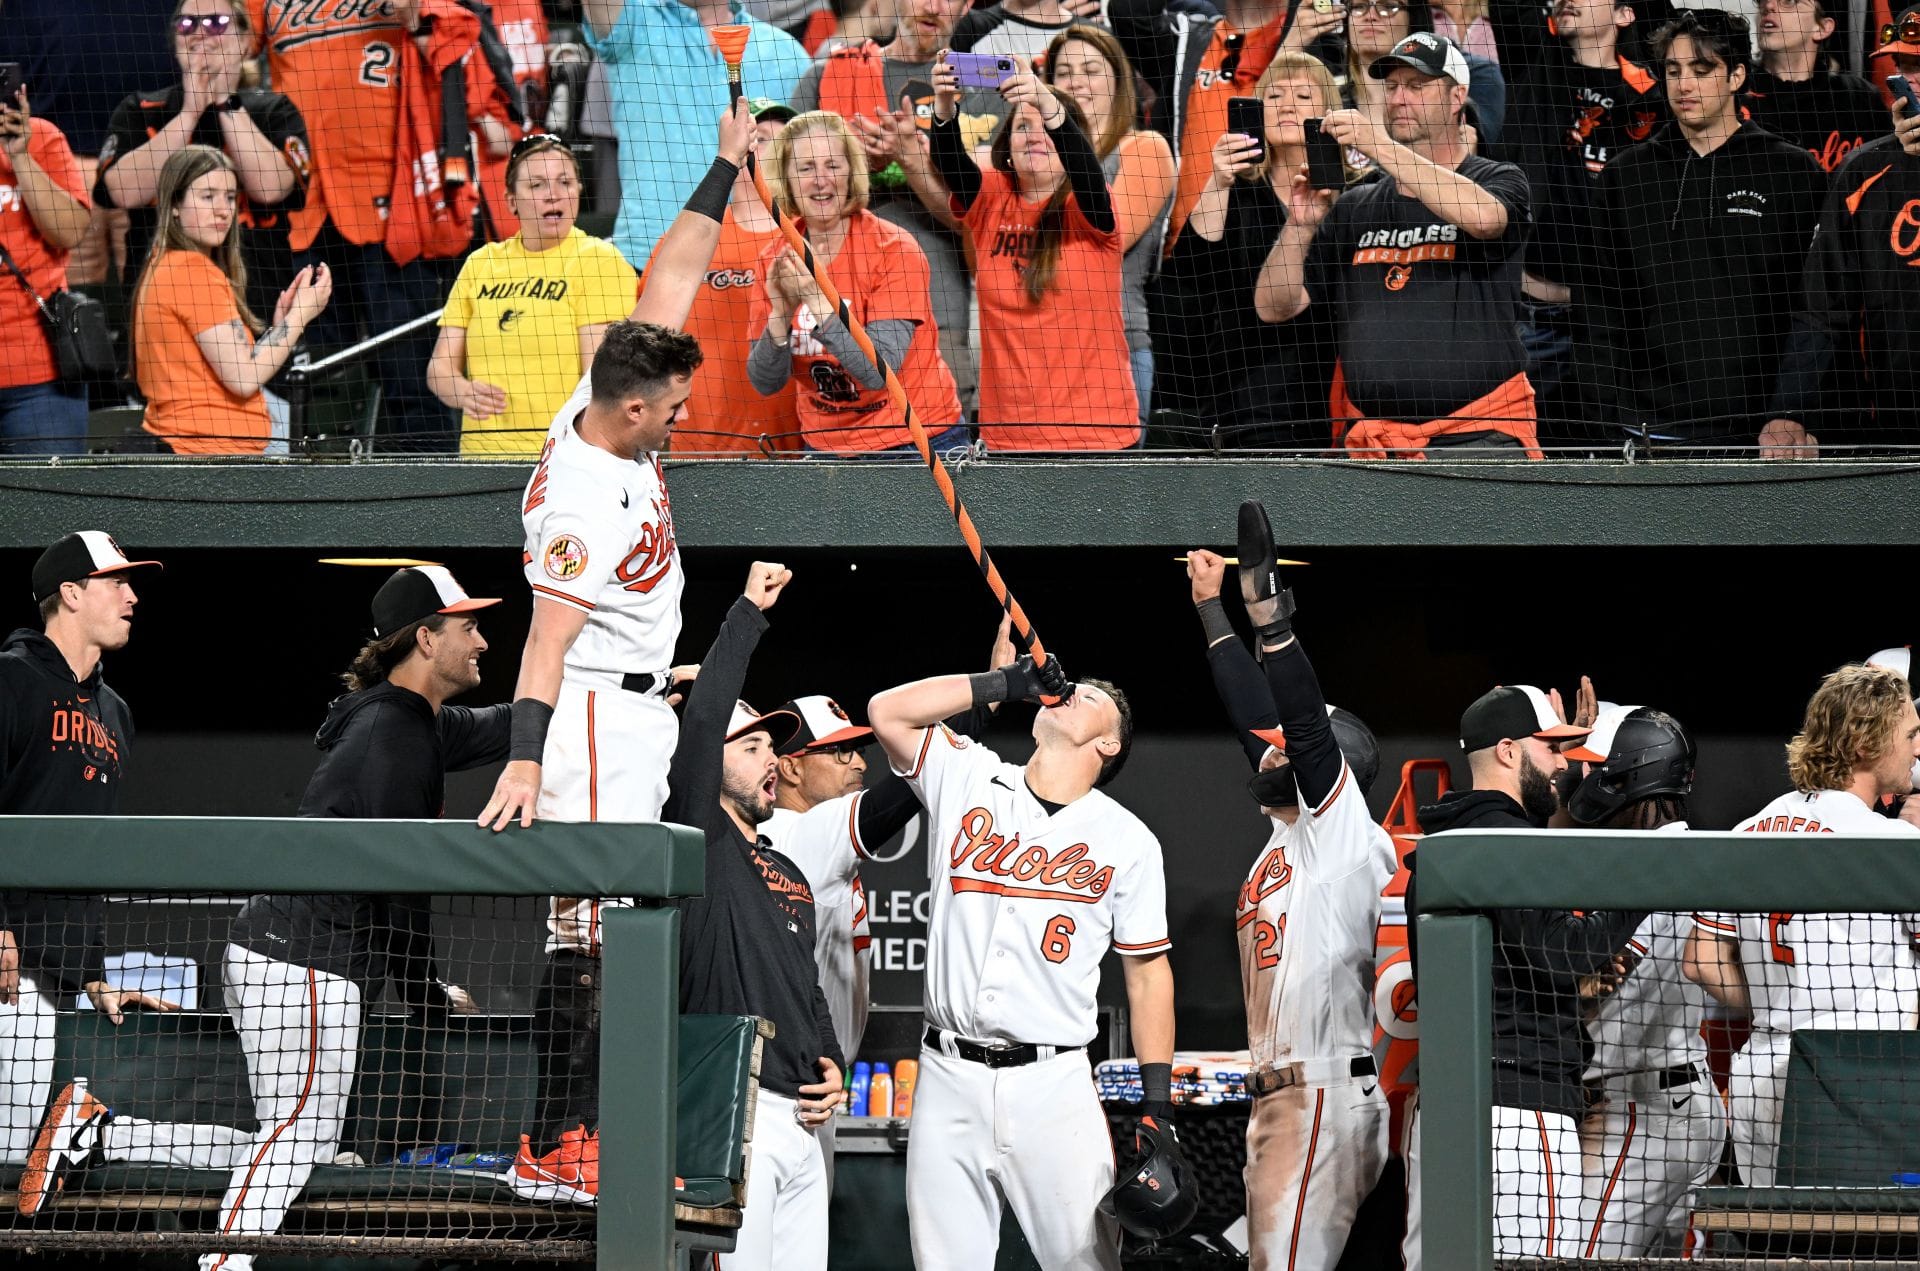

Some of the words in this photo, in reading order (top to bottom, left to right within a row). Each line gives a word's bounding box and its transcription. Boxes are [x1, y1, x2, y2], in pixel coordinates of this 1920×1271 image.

[1358, 224, 1457, 249] ORIOLES
[476, 276, 568, 302] MUSTARD
[950, 806, 1116, 900] Orioles
[1040, 913, 1077, 965] 6
